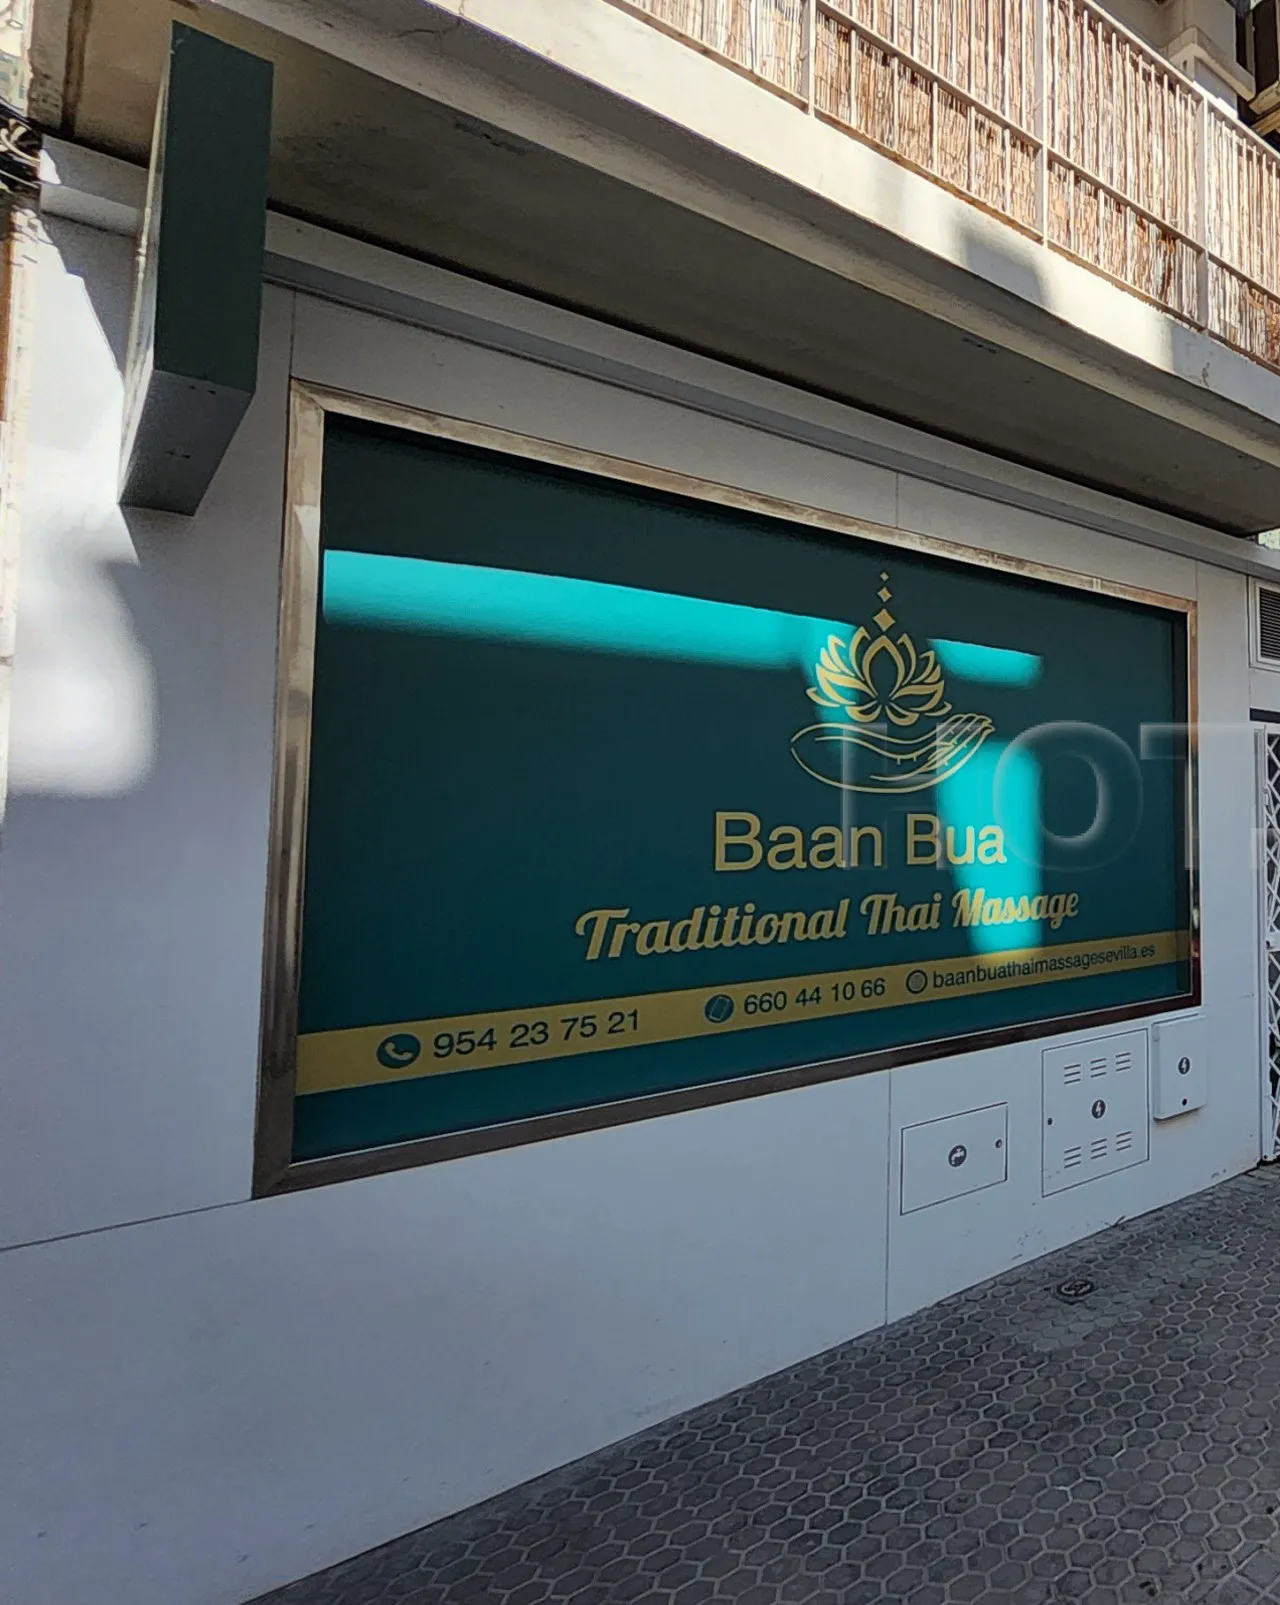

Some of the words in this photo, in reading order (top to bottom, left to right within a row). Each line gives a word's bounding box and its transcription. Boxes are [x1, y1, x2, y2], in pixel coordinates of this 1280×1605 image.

[713, 811, 883, 871] Baan
[905, 813, 1008, 866] Bua
[575, 899, 850, 960] Traditional
[861, 892, 941, 935] Thai
[951, 889, 1079, 929] Massage
[932, 944, 1156, 989] baanbuathaimassagesevilla.es
[744, 991, 787, 1015] 660
[795, 988, 822, 1008] 44
[831, 982, 856, 1002] 10
[861, 978, 886, 998] 66
[433, 1028, 497, 1058] 954
[509, 1022, 549, 1048] 23
[561, 1015, 597, 1041] 75
[607, 1010, 639, 1034] 21
